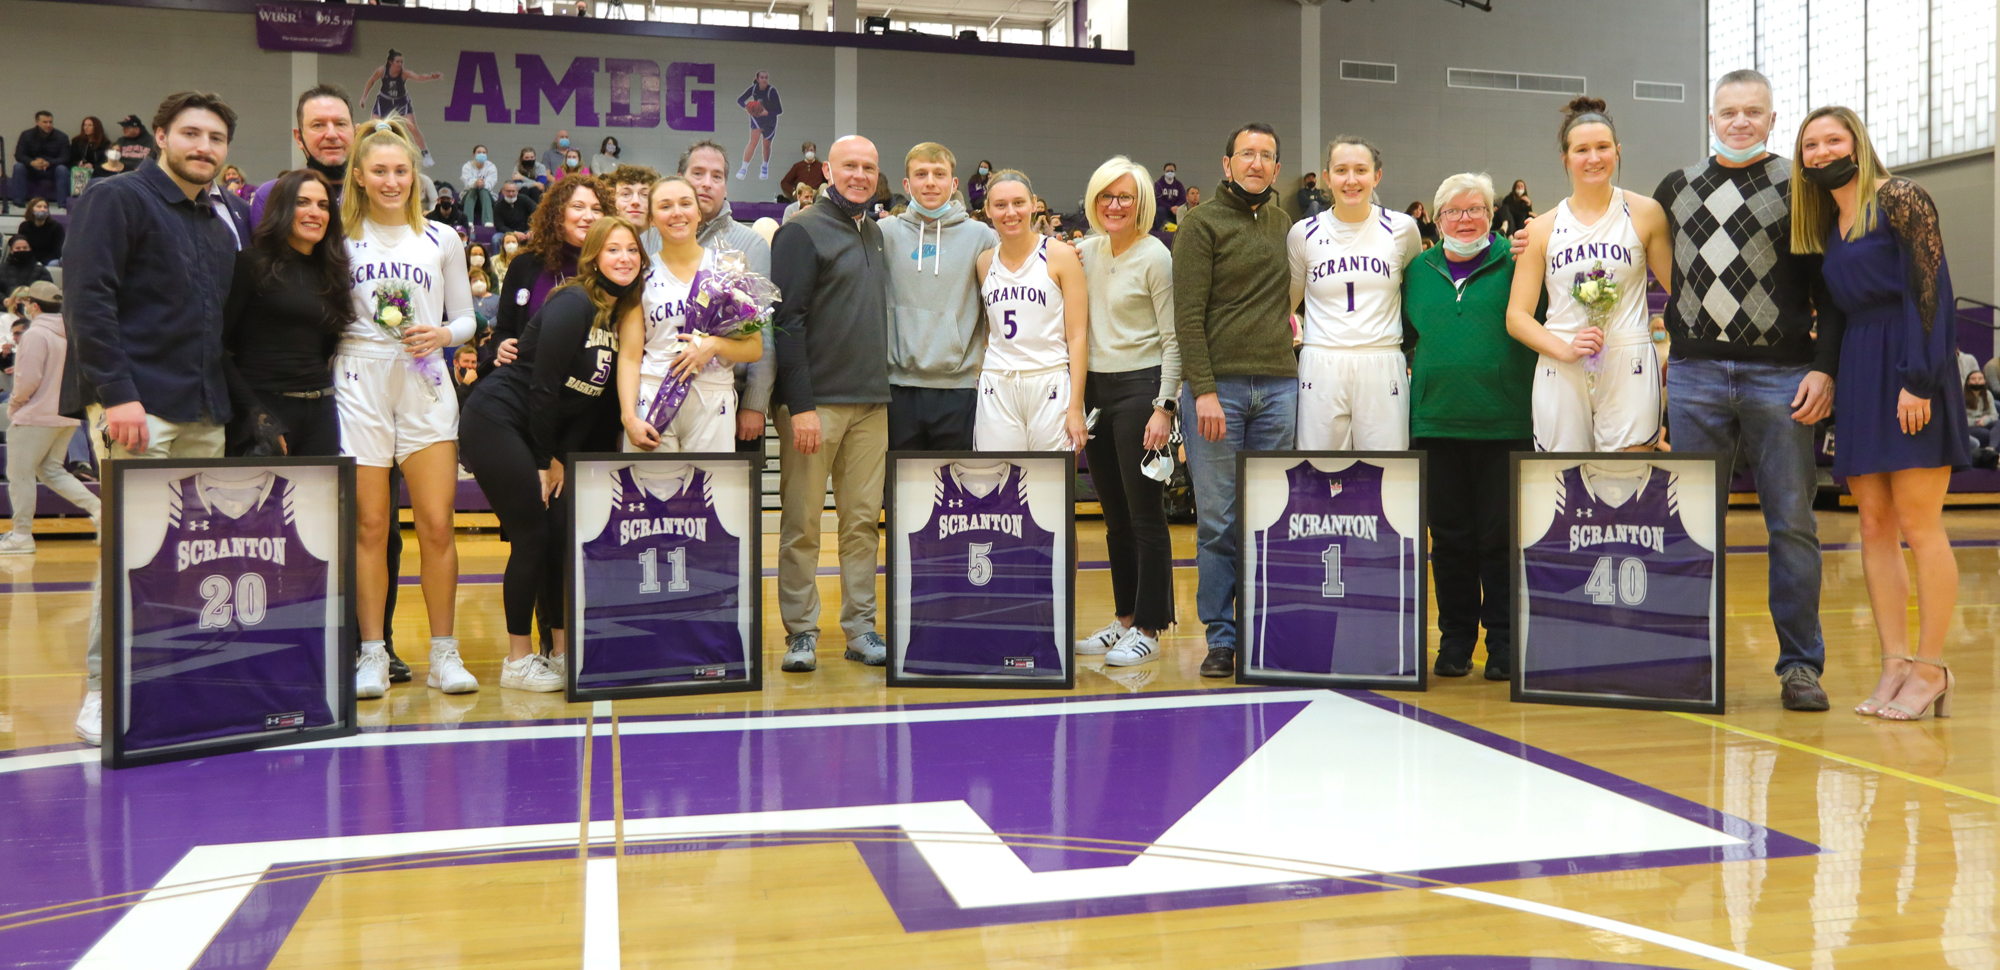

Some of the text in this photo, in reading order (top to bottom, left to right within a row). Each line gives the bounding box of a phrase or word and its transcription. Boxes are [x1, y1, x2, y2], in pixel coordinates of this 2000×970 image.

[259, 11, 297, 23] WUSR
[444, 50, 715, 132] AMDG
[1312, 255, 1390, 282] SCRANTON
[1551, 243, 1632, 275] SCRANTON
[984, 285, 1046, 308] SCRANTON
[1344, 281, 1356, 312] 1
[650, 299, 686, 328] SCRA
[1003, 310, 1018, 339] 5
[565, 375, 605, 397] BASKET
[620, 517, 707, 546] SCRANTON
[938, 513, 1023, 540] SCRANTON
[1288, 513, 1379, 542] SCRANTON
[1569, 524, 1665, 553] SCRANTON
[177, 537, 287, 573] SCRANTON
[967, 541, 993, 586] 5
[638, 547, 690, 594] 11
[1321, 544, 1344, 597] 1
[1584, 557, 1648, 605] 40
[199, 572, 267, 629] 20
